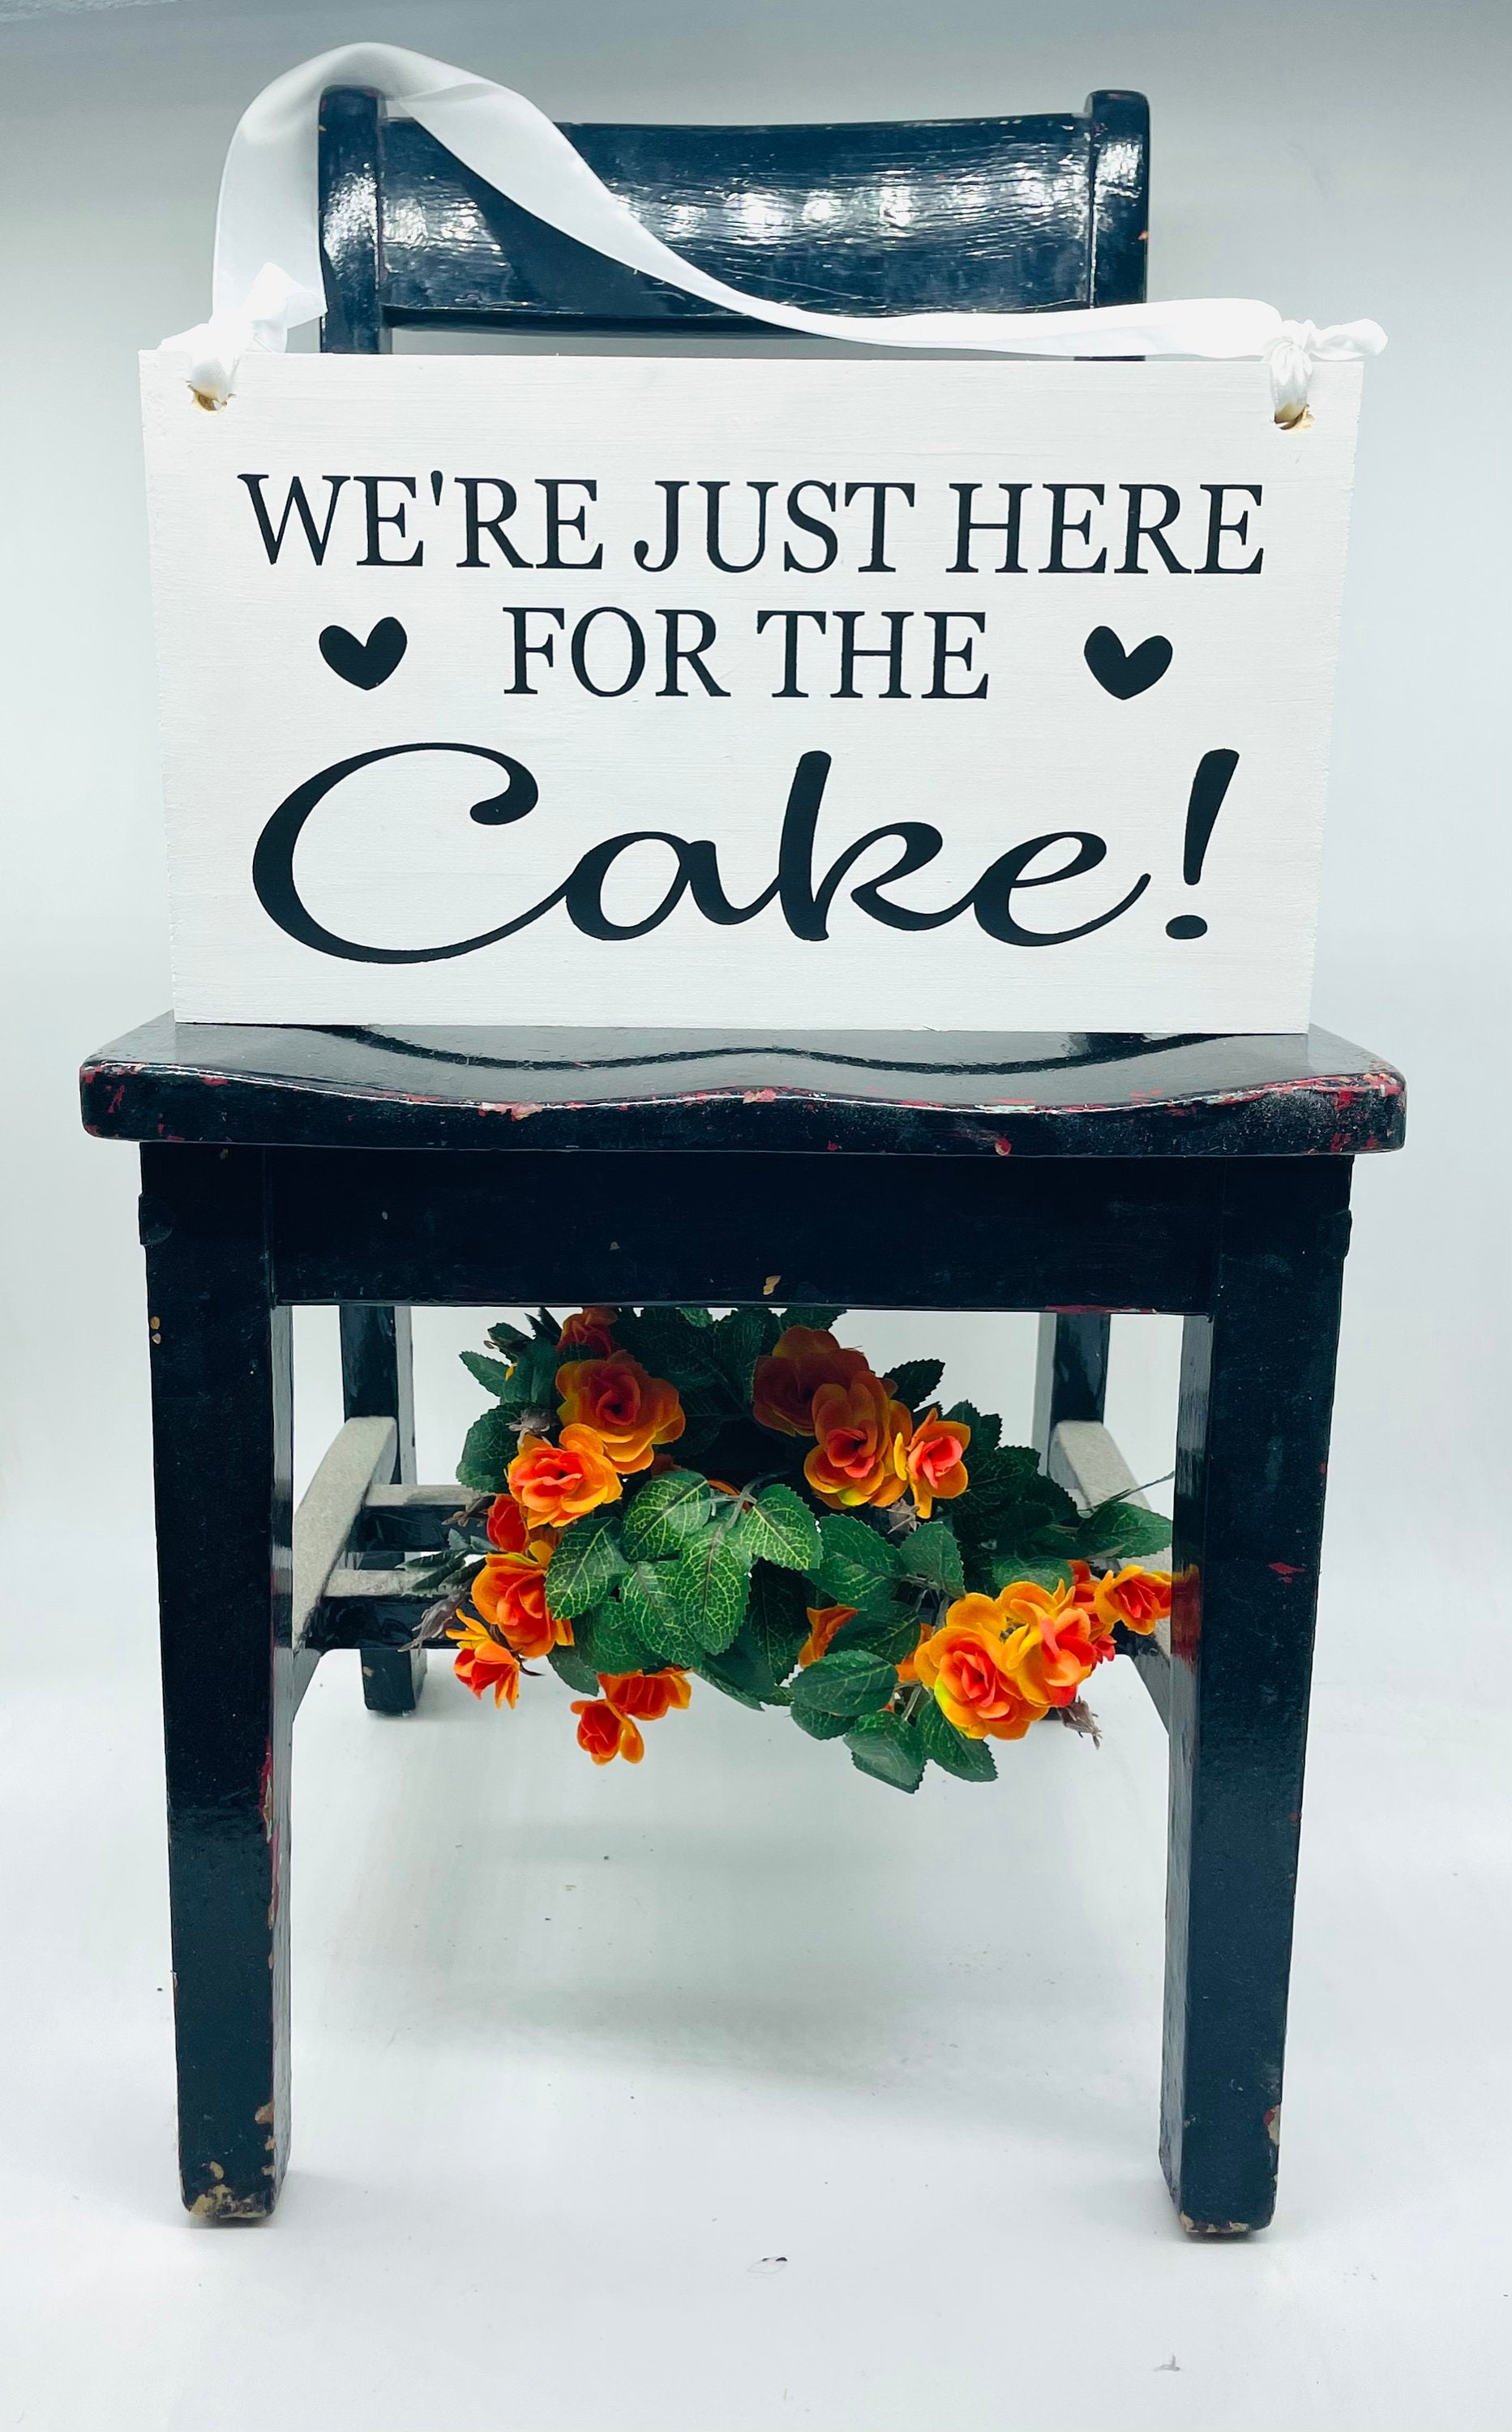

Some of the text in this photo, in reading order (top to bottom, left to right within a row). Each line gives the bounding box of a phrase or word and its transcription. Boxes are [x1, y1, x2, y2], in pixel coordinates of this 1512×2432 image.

[237, 470, 1264, 575] WE'RE JUST HERE
[502, 606, 989, 700] FOR THE
[251, 742, 1240, 965] Cake!
